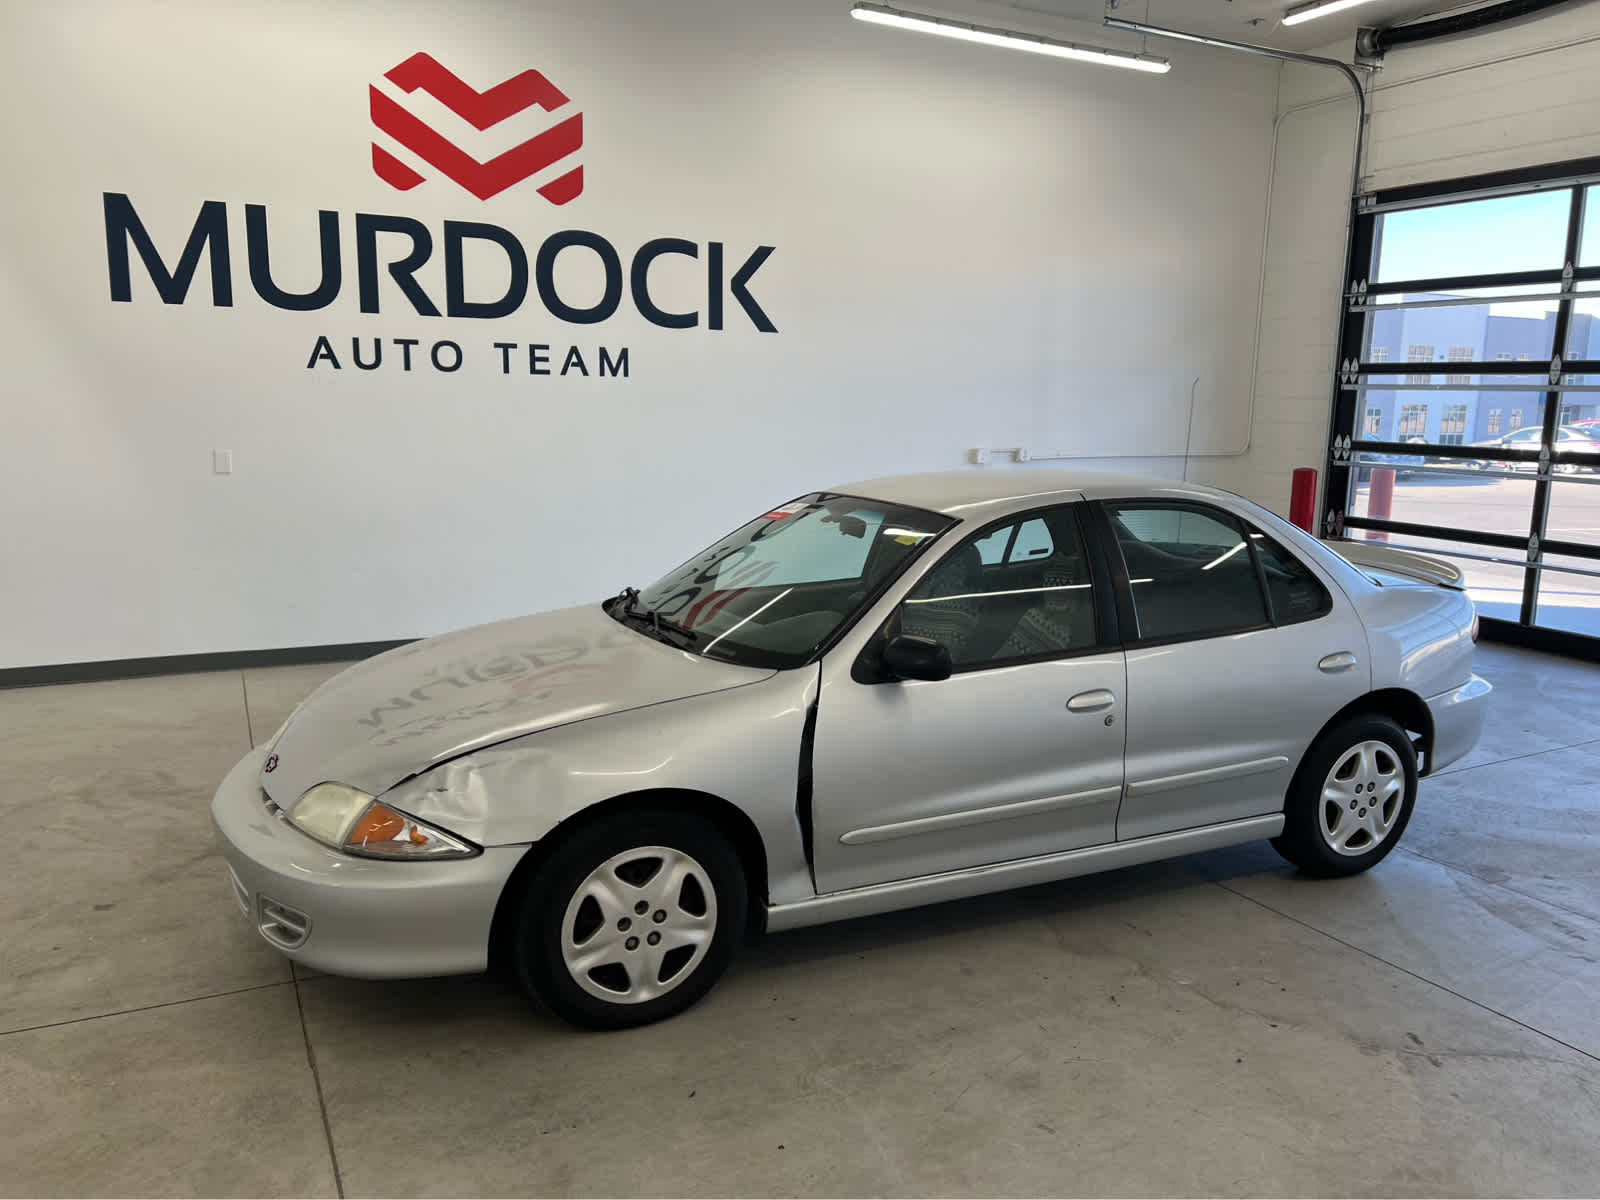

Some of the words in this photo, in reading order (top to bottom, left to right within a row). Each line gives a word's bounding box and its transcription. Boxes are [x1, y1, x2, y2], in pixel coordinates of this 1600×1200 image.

[103, 191, 779, 334] MURDOCK
[306, 335, 463, 373] AUTO
[493, 342, 630, 378] TEAM
